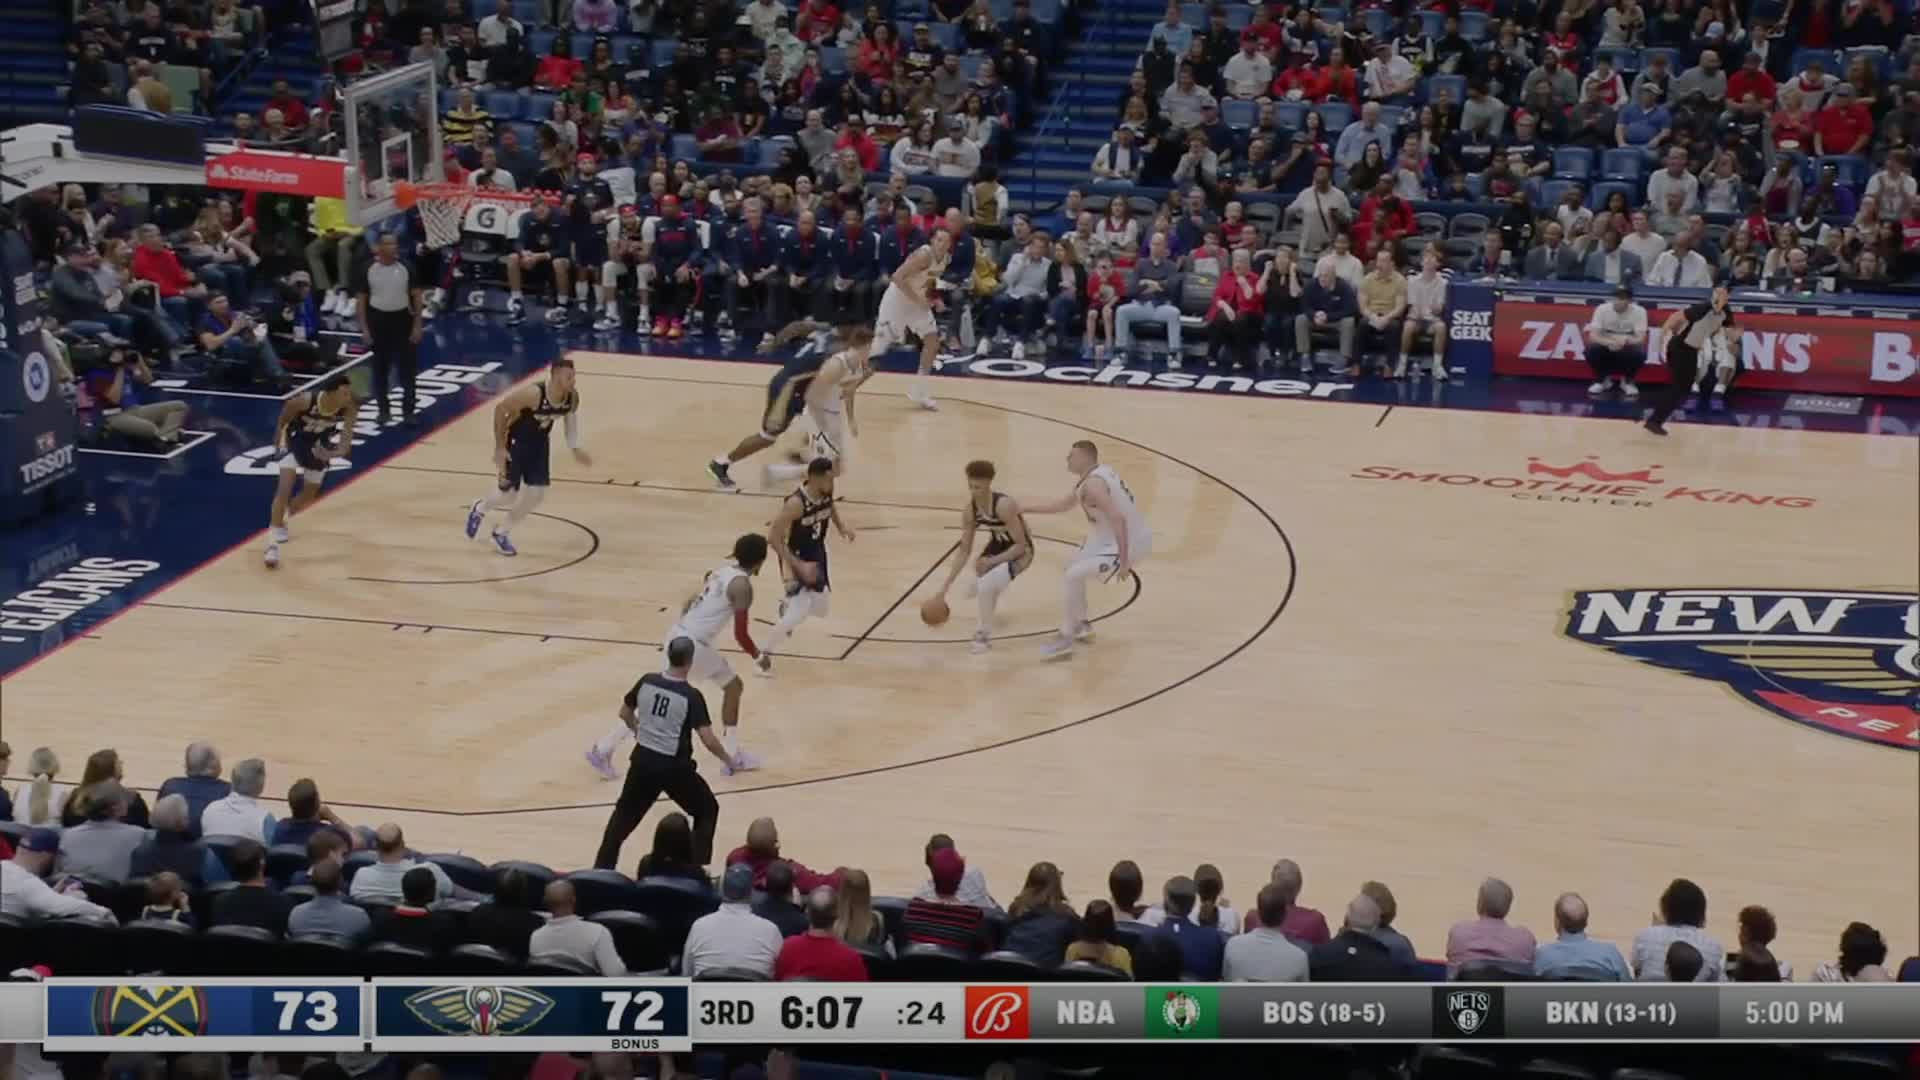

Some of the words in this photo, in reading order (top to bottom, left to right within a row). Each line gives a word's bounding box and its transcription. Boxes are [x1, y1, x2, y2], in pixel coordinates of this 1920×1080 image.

[477, 207, 497, 228] G
[1452, 310, 1492, 326] SEAT
[1450, 326, 1493, 343] GEEK
[969, 357, 1354, 398] Ochsner
[21, 444, 73, 483] TISSOT
[1350, 466, 1648, 497] SMOOTHIE
[1511, 492, 1653, 508] CENTER
[0, 556, 161, 642] ELICANS
[1578, 590, 1858, 635] NEW
[651, 693, 671, 718] 18
